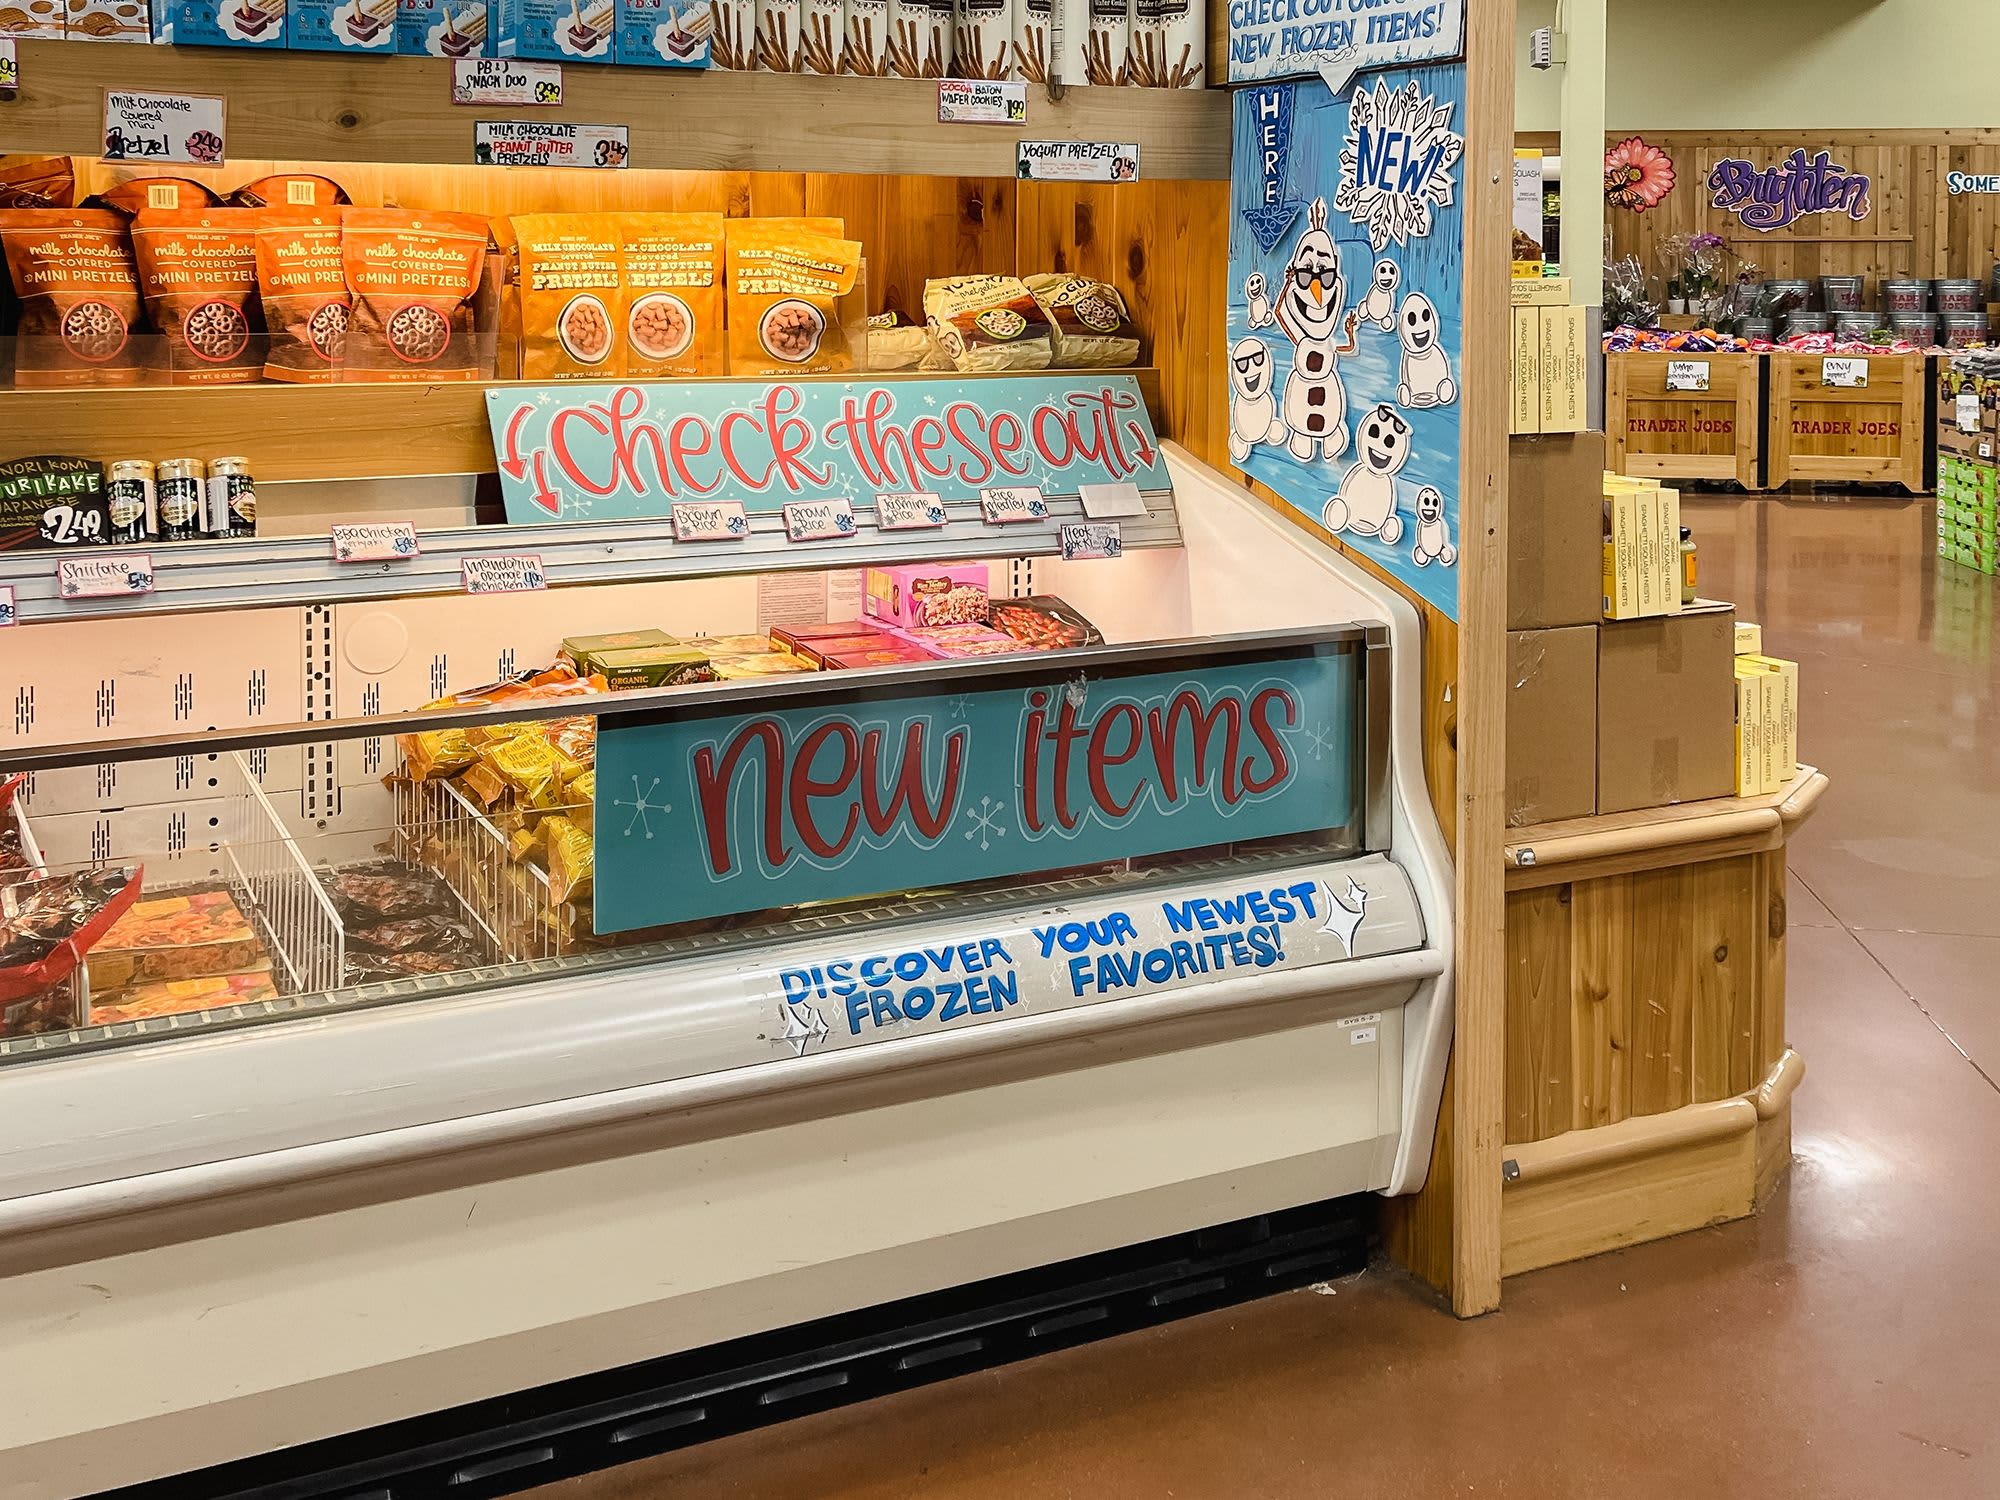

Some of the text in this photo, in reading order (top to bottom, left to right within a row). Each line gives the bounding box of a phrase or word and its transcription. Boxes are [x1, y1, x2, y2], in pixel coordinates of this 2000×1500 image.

[1230, 0, 1300, 29] CHECK
[1232, 2, 1445, 63] NEW FROZEN ITEMS!
[466, 74, 527, 89] SNACK DUO
[941, 83, 1002, 95] COCOA BATON
[942, 92, 1004, 107] WAFER COOKIES
[489, 124, 578, 137] MILK CHOCOLATE
[493, 140, 574, 154] PEANUT BUTTER
[1023, 143, 1120, 160] YOGURT PRETZELS
[1260, 93, 1279, 203] HERE
[497, 153, 550, 166] PRETZELS
[1356, 126, 1446, 197] NEW!
[1708, 150, 1868, 227] Brighten
[30, 242, 64, 257] milk
[154, 241, 256, 258] milk chocolate
[277, 240, 343, 257] milk choco
[365, 242, 467, 262] milk chocolate
[531, 243, 616, 253] MILK CHOCOLATE
[639, 243, 713, 253] CHOCOLATE
[59, 258, 112, 269] COVERED
[182, 259, 237, 269] COVERED
[303, 258, 342, 268] COVERE
[635, 252, 679, 261] covered
[738, 249, 773, 260] MILK
[774, 251, 845, 274] CHOCOLATE
[391, 260, 444, 271] COVERED
[532, 261, 618, 272] PEANUT BUTTER
[660, 261, 713, 271] BUTTER
[35, 270, 68, 283] MINI
[158, 272, 190, 284] MINI
[281, 272, 311, 285] MINI
[366, 272, 468, 288] MINI PRETZELS
[532, 273, 619, 290] PRETZELS
[627, 273, 713, 287] ETZELS
[738, 268, 789, 280] PEANUT
[1628, 418, 1687, 433] TRADER
[1793, 420, 1851, 436] TRADER
[551, 385, 831, 497] Check
[4, 473, 100, 497] URIKAKE
[989, 490, 1015, 501] Rice
[63, 562, 130, 579] Shiitake
[610, 675, 649, 684] ORGANIC
[692, 687, 1299, 878] new items
[780, 881, 1320, 1005] DISCOVER YOUR NEWEST
[847, 923, 1287, 1035] FROZEN FAVORITES!
